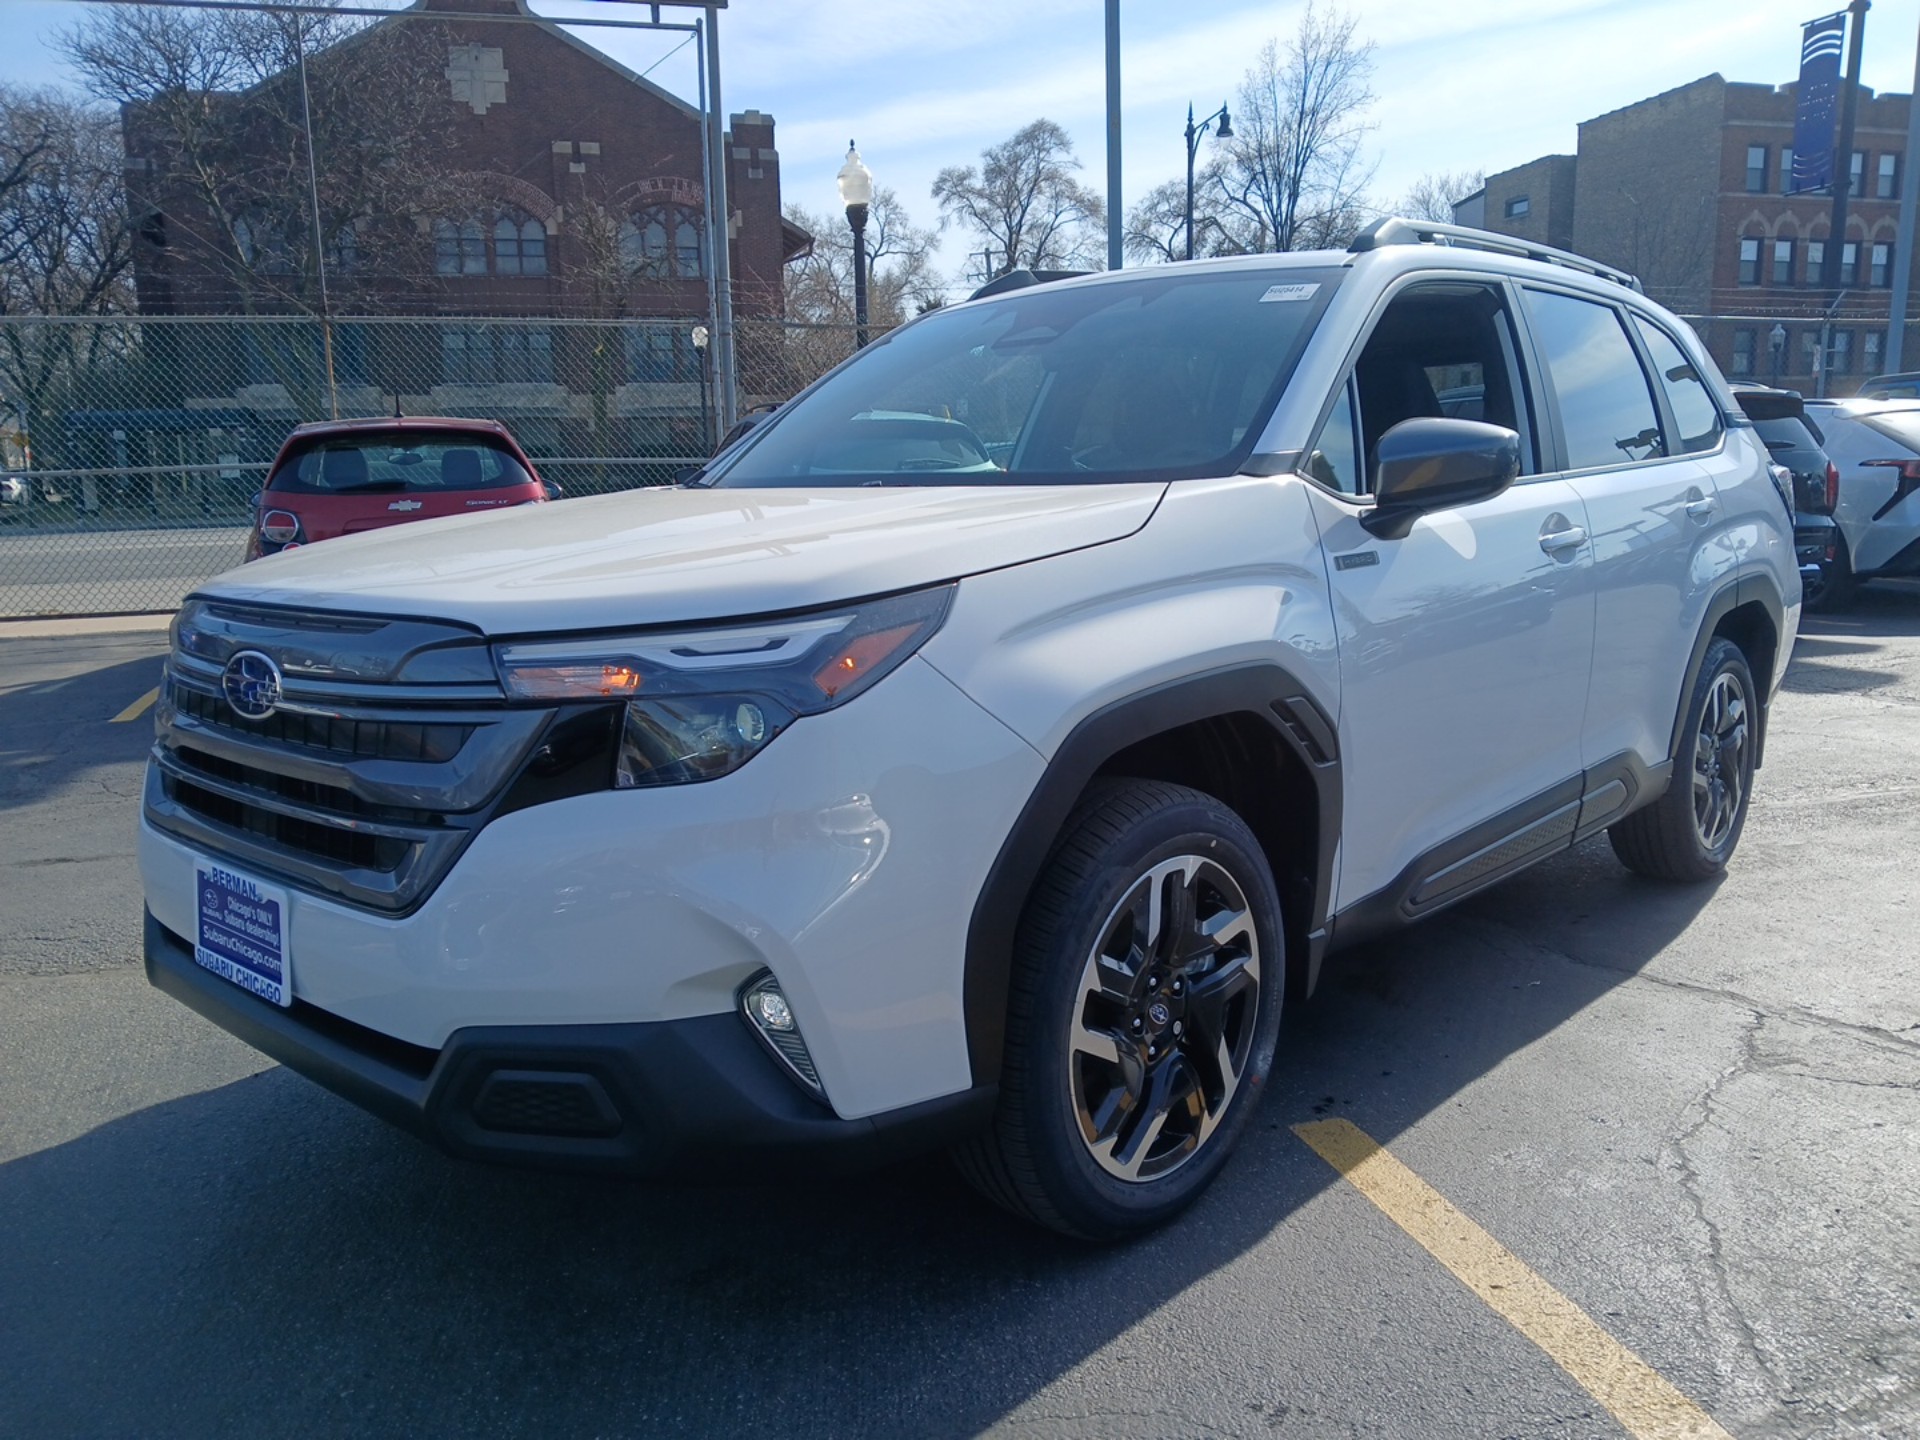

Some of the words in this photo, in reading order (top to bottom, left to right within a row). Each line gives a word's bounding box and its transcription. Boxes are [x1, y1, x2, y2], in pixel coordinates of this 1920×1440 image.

[211, 866, 257, 901] BERMAN
[224, 910, 245, 931] Subaru
[227, 896, 256, 919] Chicago's
[256, 908, 273, 926] ONLY
[203, 925, 281, 970] SubaruChicago.com
[196, 947, 233, 979] SUBARU
[235, 968, 281, 1003] CHICAGO
